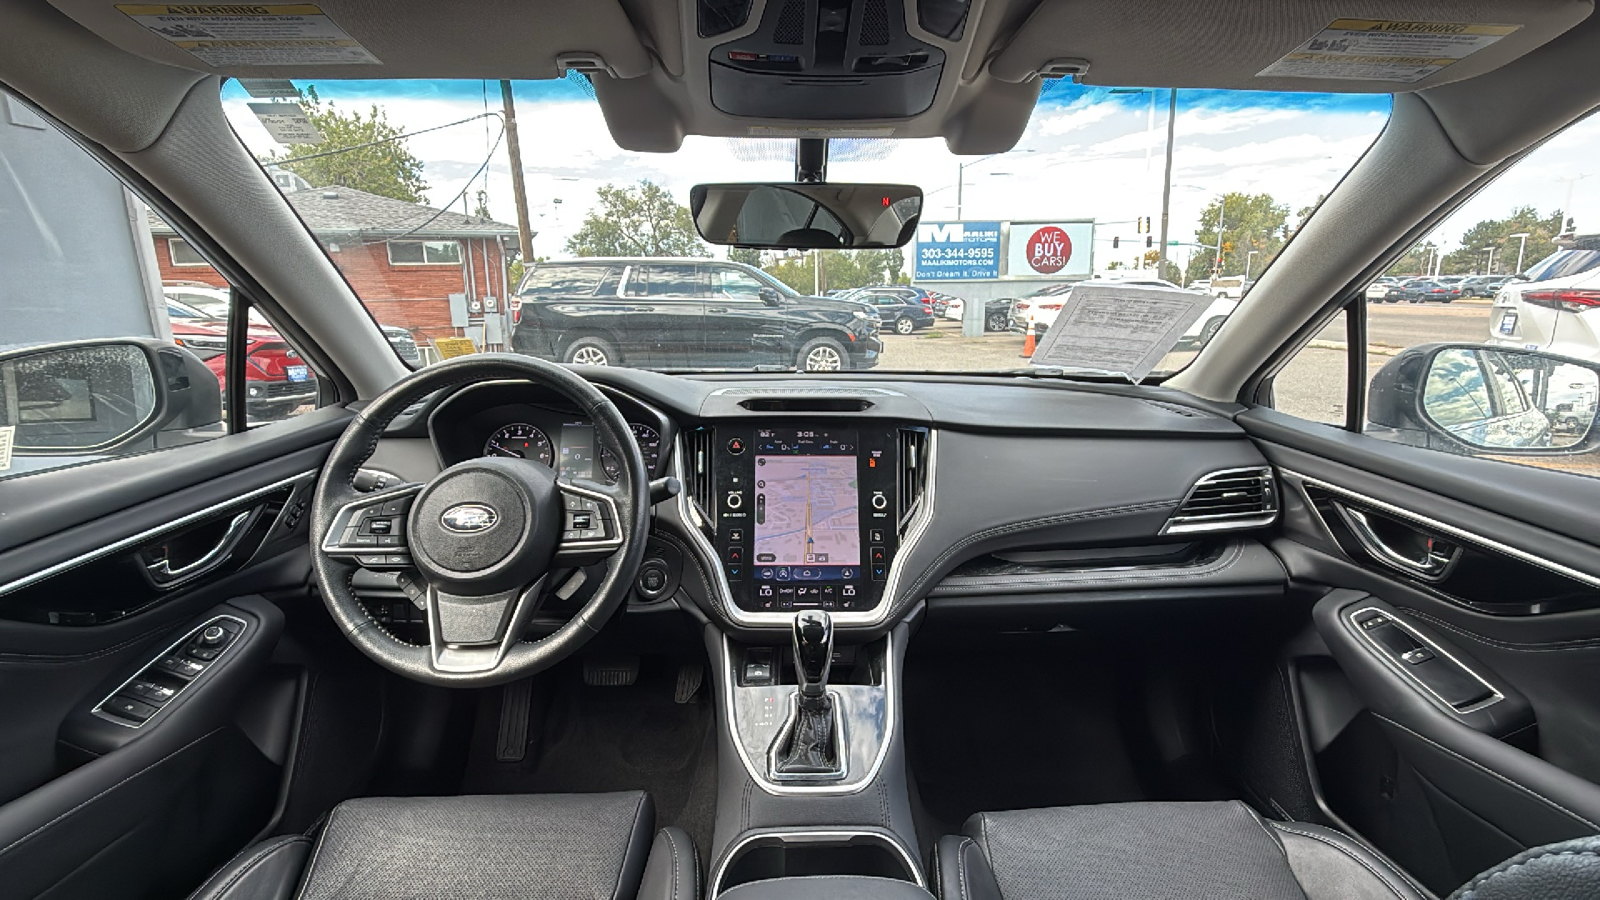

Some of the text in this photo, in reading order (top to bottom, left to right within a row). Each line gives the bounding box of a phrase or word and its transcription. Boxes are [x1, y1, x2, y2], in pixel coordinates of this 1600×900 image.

[178, 6, 269, 15] WARNING
[1384, 23, 1467, 33] WARNING
[882, 197, 889, 206] N
[1040, 231, 1060, 243] WE
[921, 248, 994, 258] 303-344-9595
[1035, 243, 1064, 257] BUY
[1032, 256, 1066, 267] CARS!
